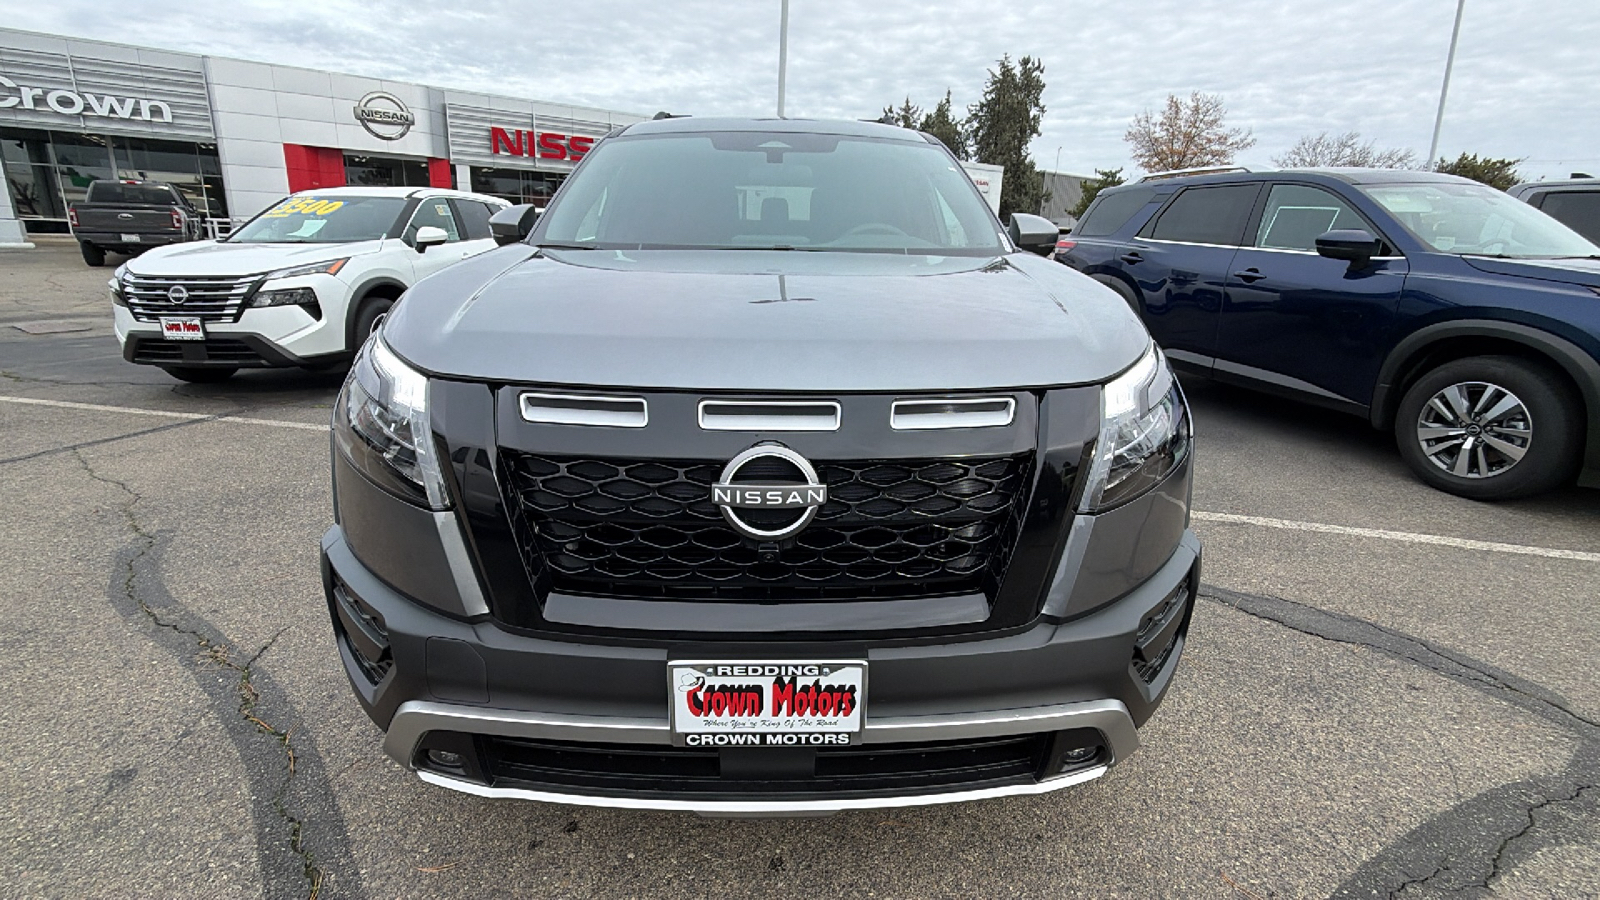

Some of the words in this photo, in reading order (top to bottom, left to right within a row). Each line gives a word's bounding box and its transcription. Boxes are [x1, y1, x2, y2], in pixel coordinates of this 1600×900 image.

[361, 109, 409, 122] NISSAN
[714, 487, 824, 505] NISSAN
[717, 665, 820, 676] REDDING
[686, 676, 764, 718] Crown
[771, 676, 857, 718] Motors
[703, 719, 728, 727] Where
[760, 719, 781, 728] King
[784, 719, 795, 728] Of
[798, 718, 813, 727] The
[816, 718, 839, 727] Road
[686, 733, 761, 746] CROWN
[766, 733, 850, 746] MOTORS
